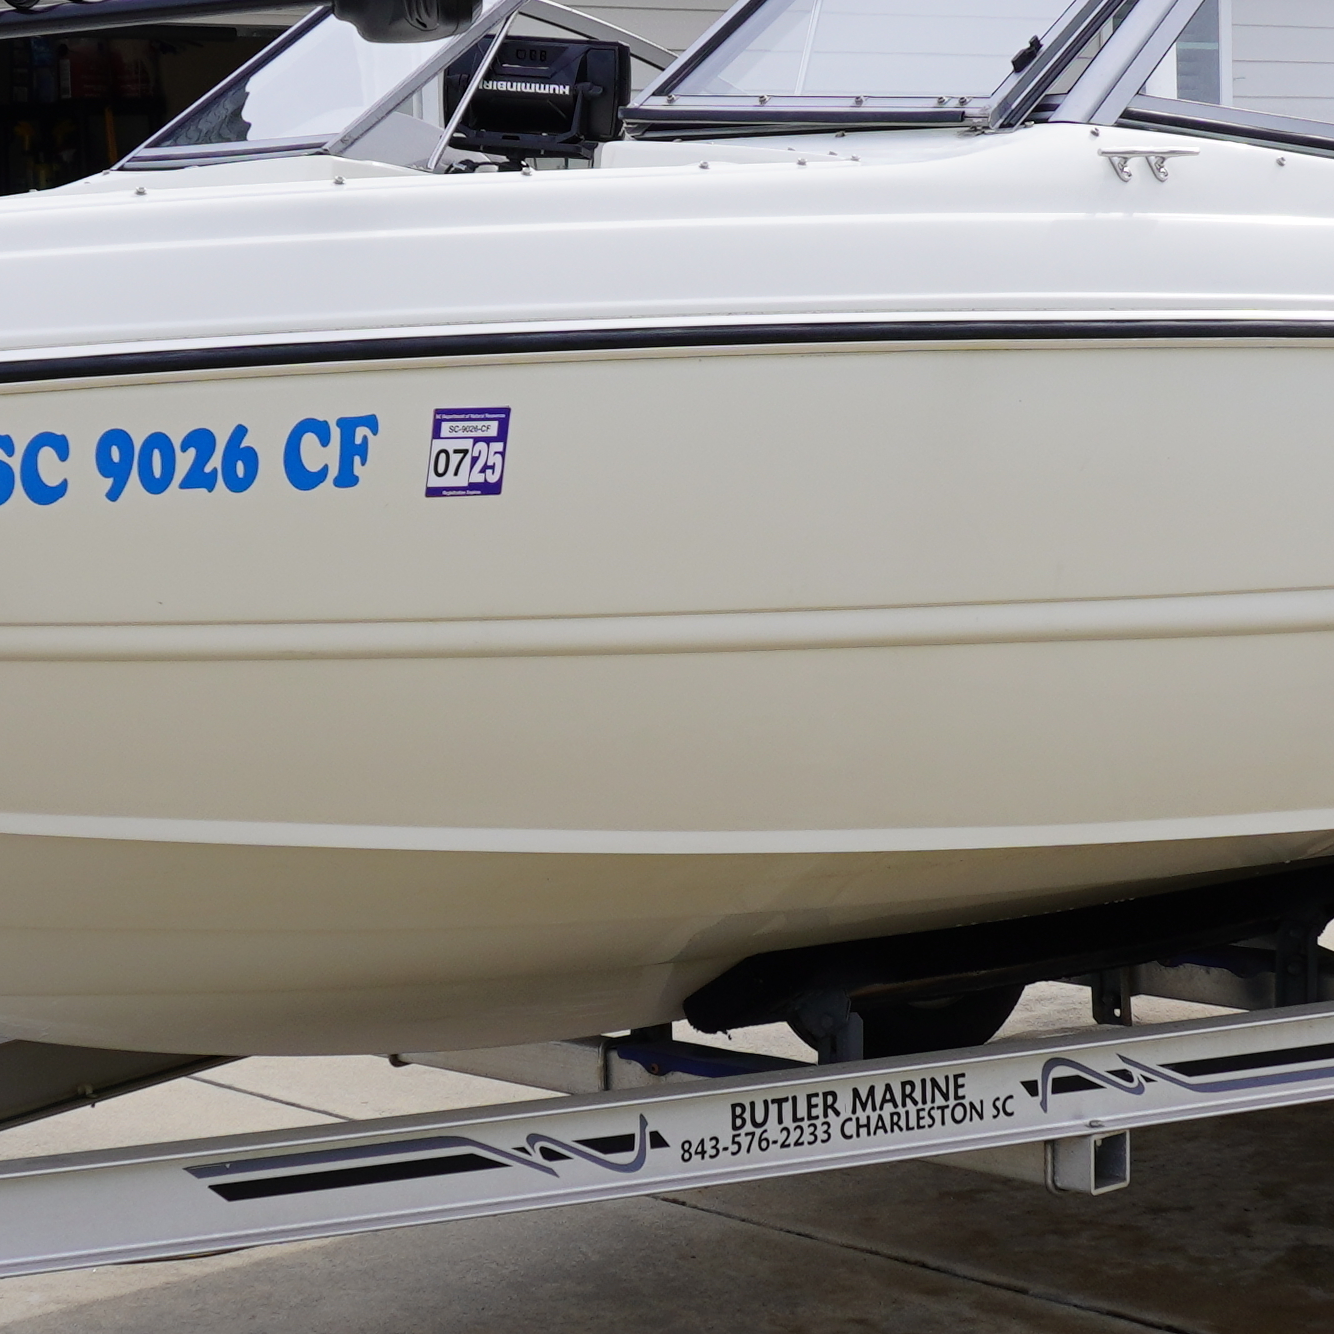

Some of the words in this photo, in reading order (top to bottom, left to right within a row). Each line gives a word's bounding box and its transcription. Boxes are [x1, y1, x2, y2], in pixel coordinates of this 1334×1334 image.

[95, 424, 259, 502] 9026
[283, 414, 379, 491] CF
[433, 448, 470, 478] 07
[468, 441, 504, 483] 25
[680, 1122, 832, 1163] 843-576-2233
[840, 1099, 984, 1140] CHARLESTON
[992, 1095, 1015, 1119] SC
[730, 1090, 840, 1132] BUTLER
[851, 1073, 966, 1115] MARINE
